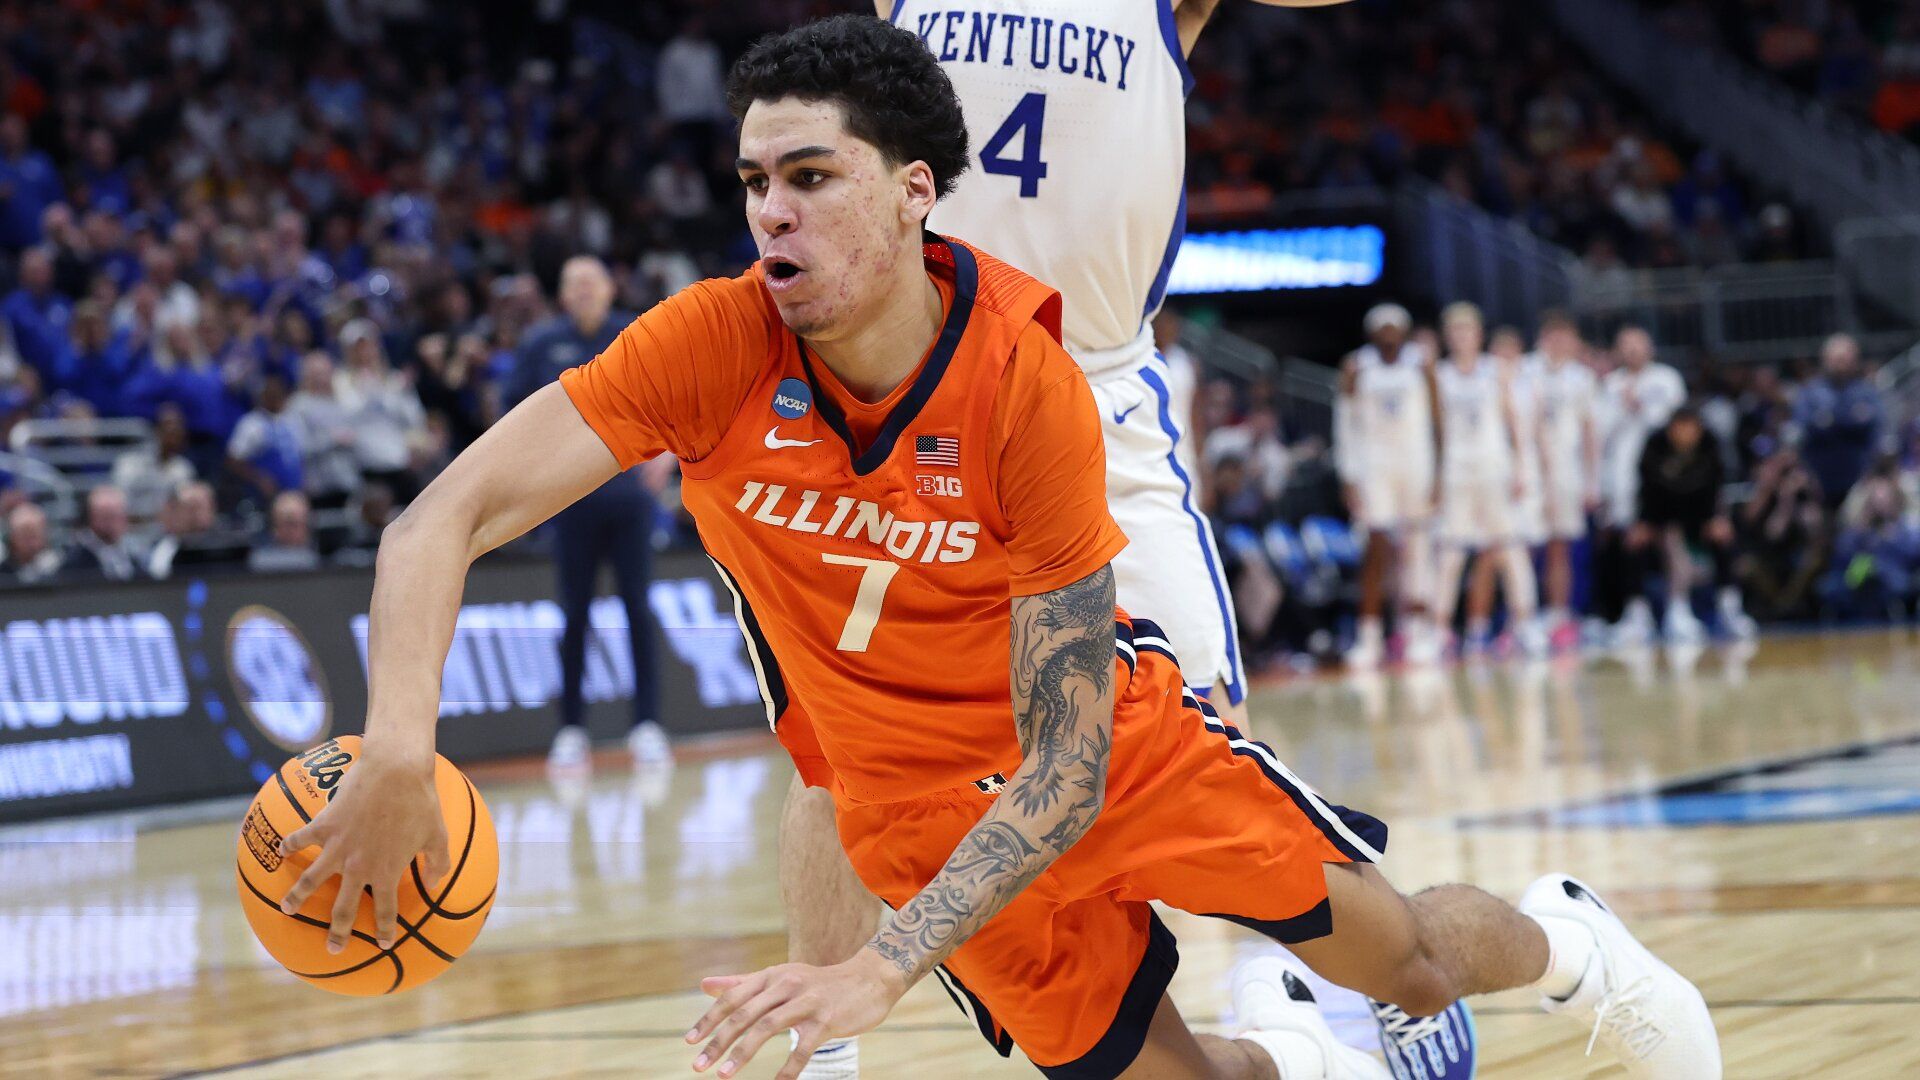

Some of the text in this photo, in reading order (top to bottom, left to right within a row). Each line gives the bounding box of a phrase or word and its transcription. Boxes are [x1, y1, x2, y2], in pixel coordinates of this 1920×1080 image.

[918, 11, 1135, 90] KENTUCKY
[979, 92, 1047, 198] 4
[774, 393, 808, 413] NCAA
[735, 481, 980, 563] ILLINOIS
[821, 553, 900, 653] 7
